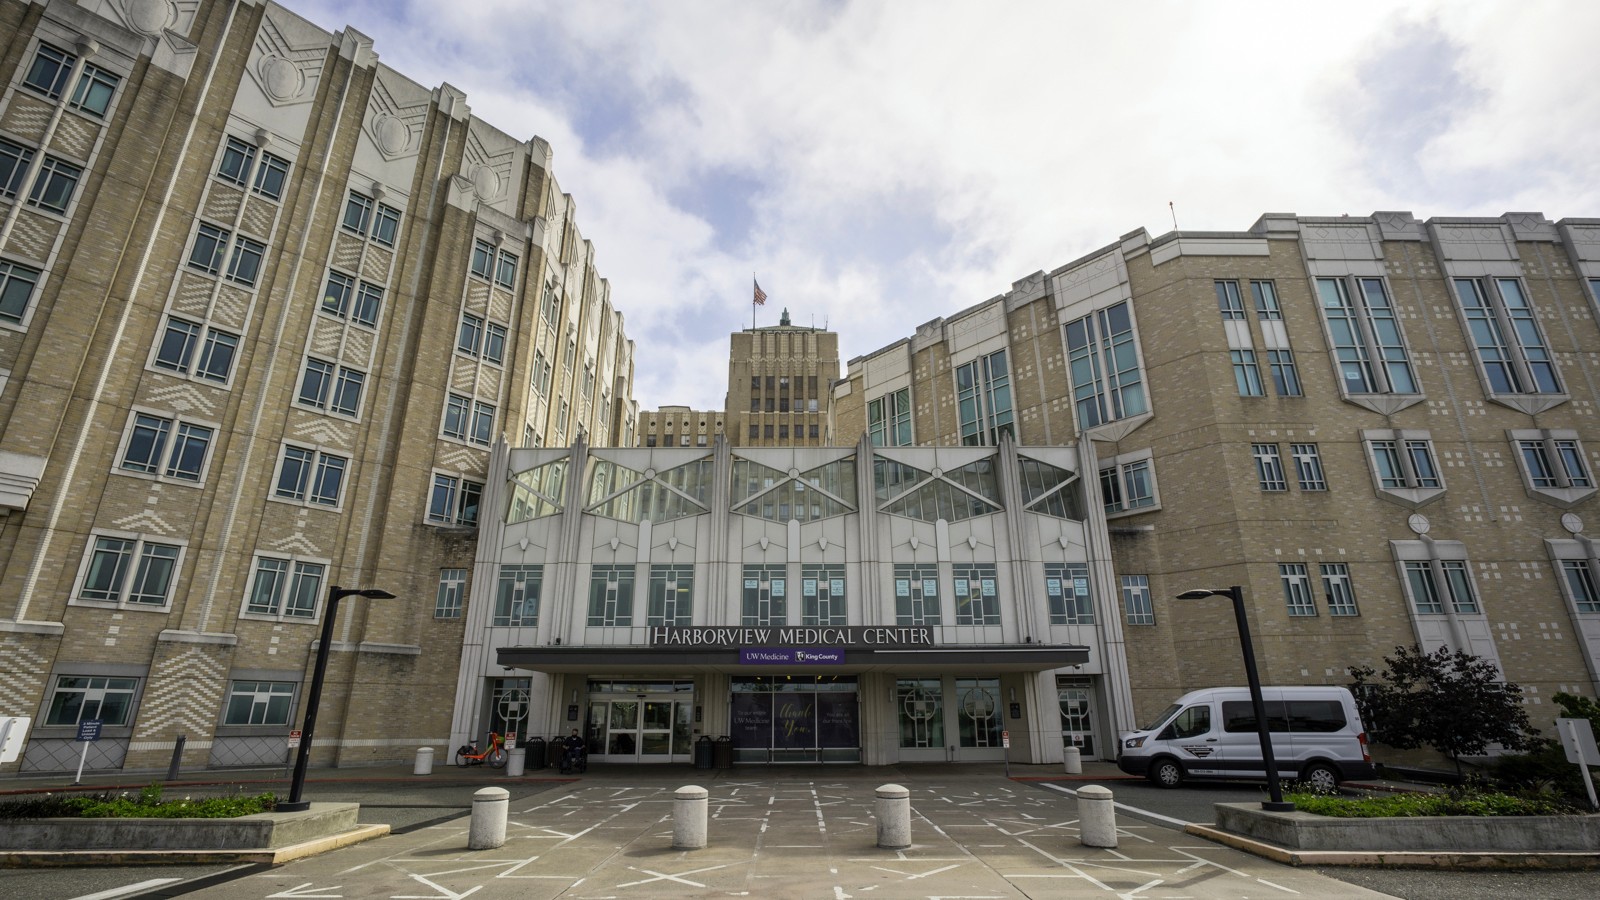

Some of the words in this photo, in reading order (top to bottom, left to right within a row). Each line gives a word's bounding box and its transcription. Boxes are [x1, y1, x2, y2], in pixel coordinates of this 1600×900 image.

[653, 627, 771, 645] HARBORVIEW
[779, 628, 856, 644] MEDICAL
[863, 628, 931, 645] CENTER
[806, 653, 818, 661] King
[818, 653, 838, 661] County
